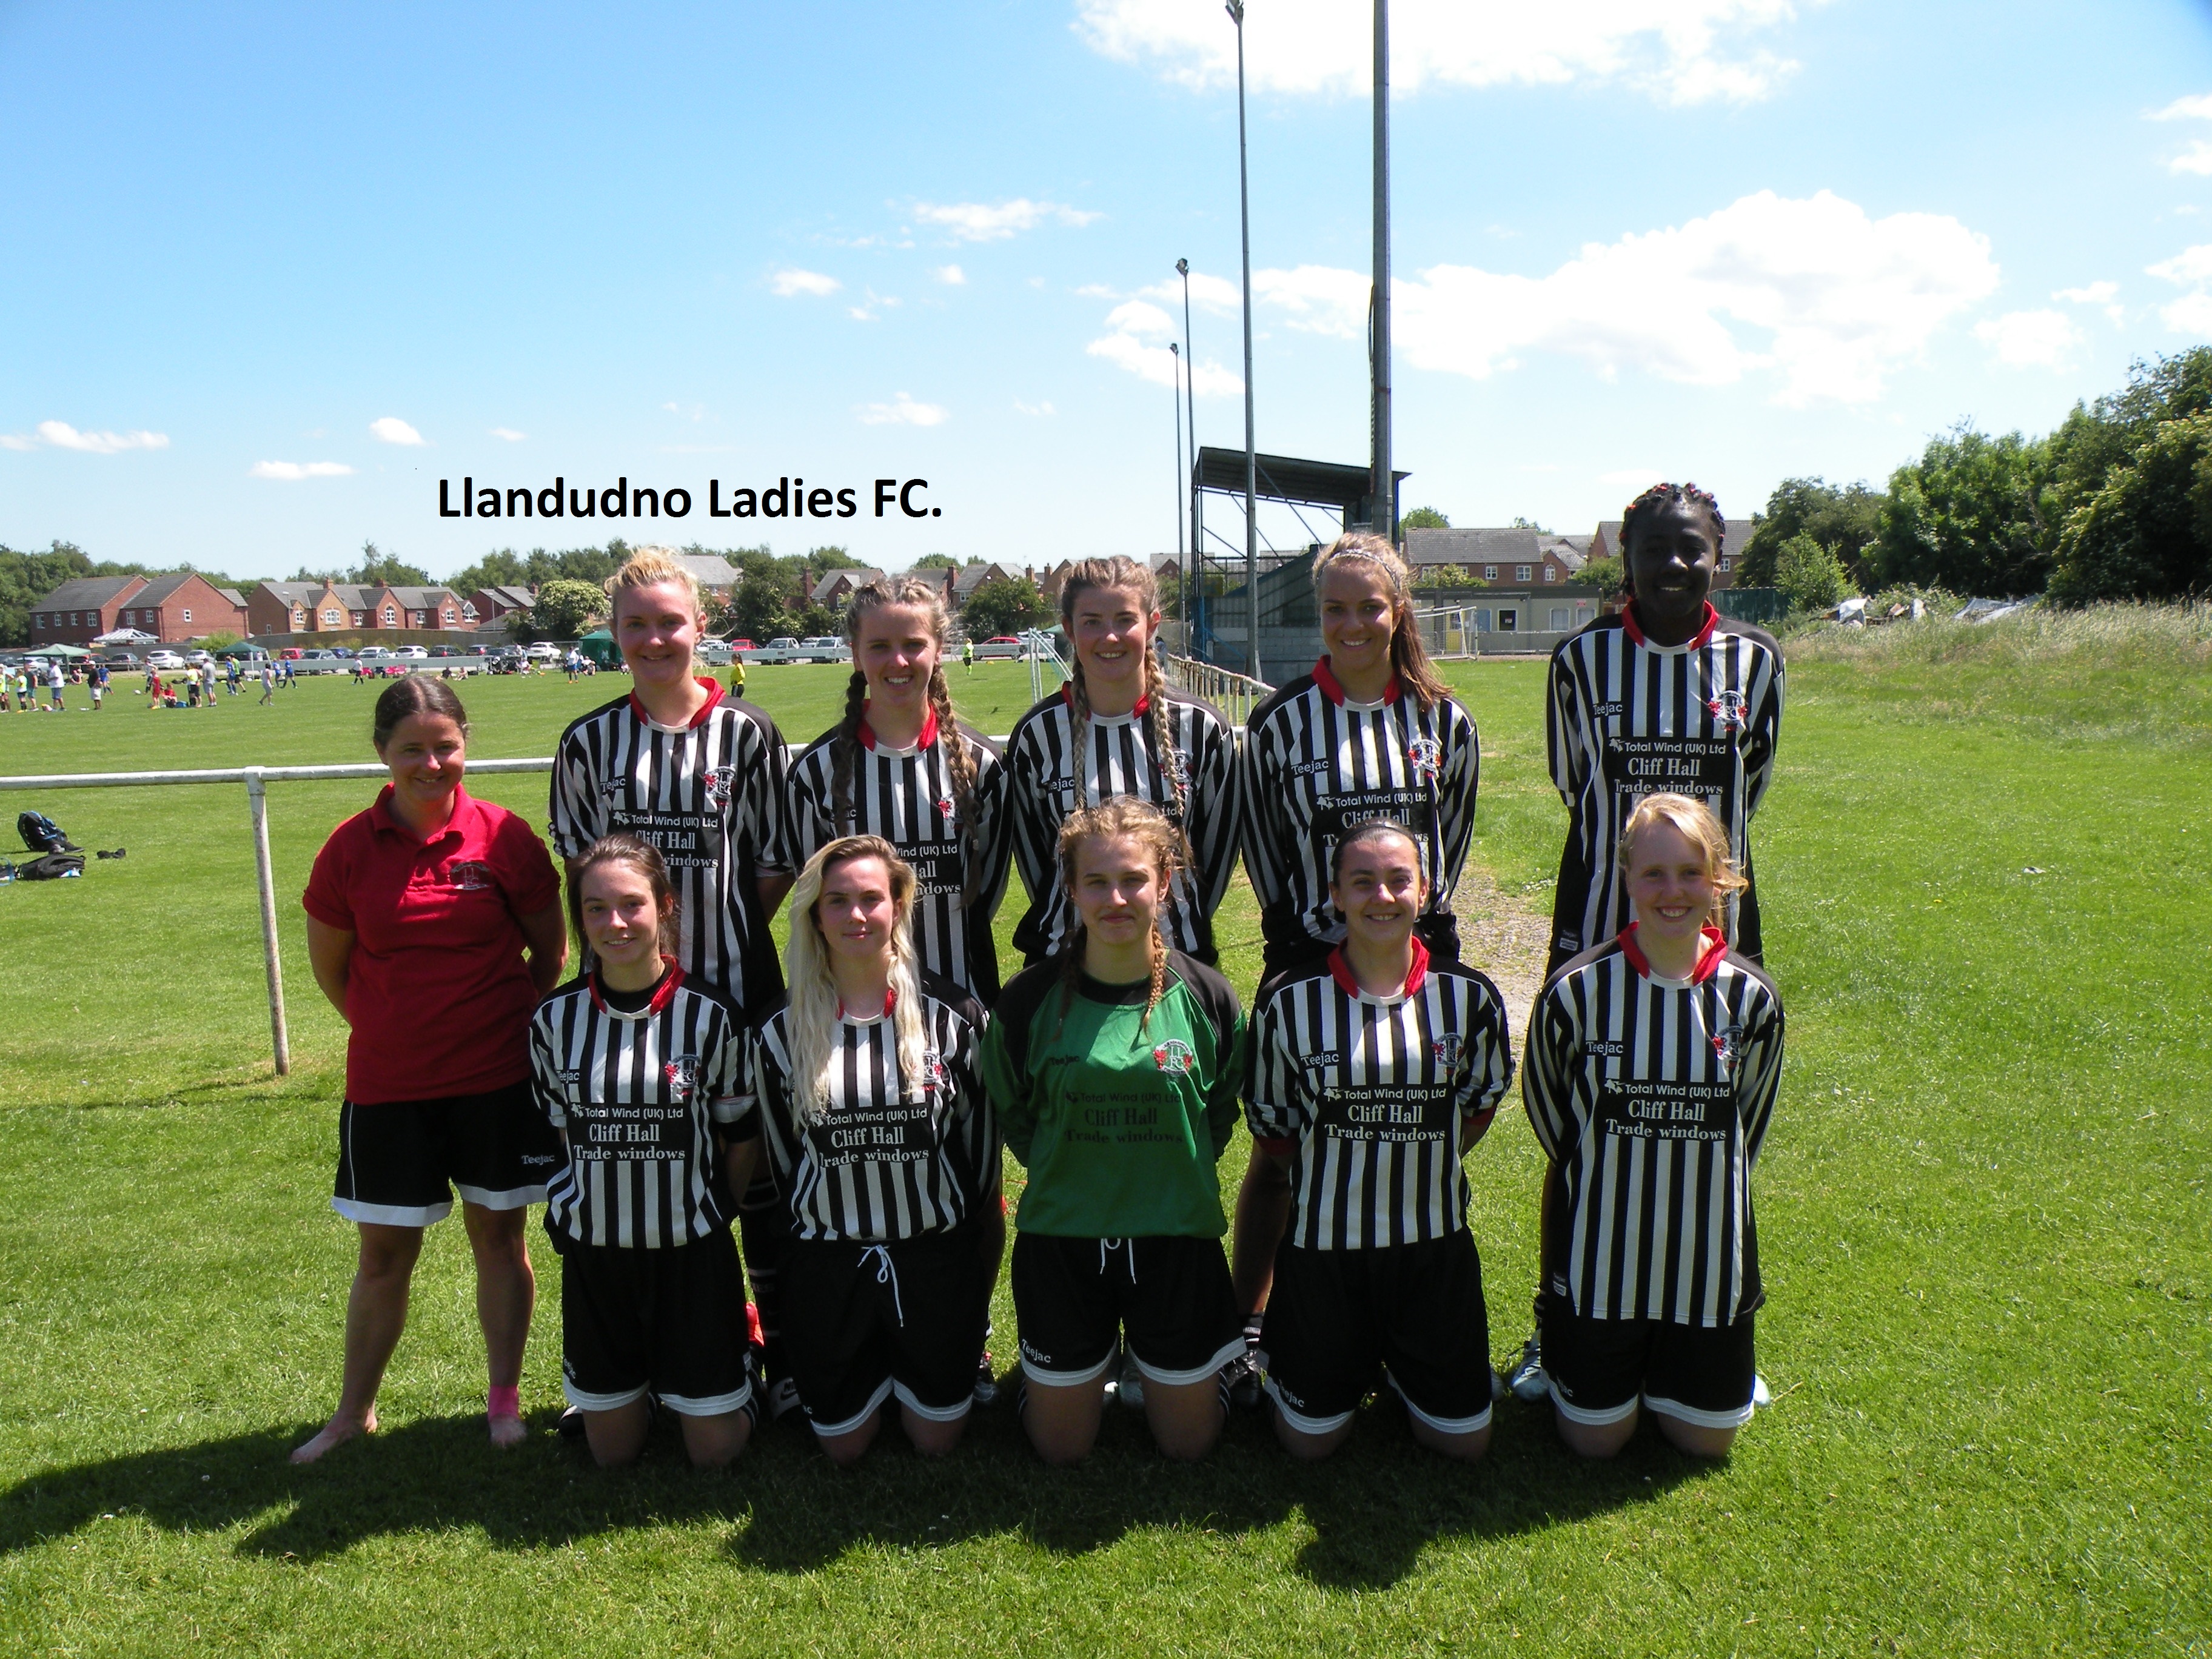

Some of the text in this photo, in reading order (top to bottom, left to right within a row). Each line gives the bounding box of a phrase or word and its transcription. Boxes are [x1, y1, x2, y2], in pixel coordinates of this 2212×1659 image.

[1593, 703, 1623, 716] Teejac
[1625, 742, 1726, 755] Total Wind (UK) Ltd
[1292, 760, 1329, 776] Teejac
[1628, 758, 1700, 777] Cliff Hall
[1614, 779, 1723, 794] Trade windows
[1336, 793, 1427, 808] Total Wind (UK) Ltd
[632, 815, 719, 828] Total Wind (UK) Ltd
[668, 832, 696, 850] Hall
[919, 846, 939, 857] (UK)
[942, 844, 958, 854] Ltd
[1586, 1041, 1623, 1056] Teejac
[1301, 1053, 1339, 1067] Teejac
[1081, 1093, 1106, 1103] Total
[1110, 1093, 1138, 1103] Wind
[1141, 1093, 1161, 1104] (UK)
[1344, 1088, 1446, 1102] Total Wind (UK) Ltd
[1626, 1084, 1730, 1099] Total Wind (UK) Ltd
[585, 1108, 683, 1120] Total Wind (UK) Ltd
[825, 1108, 928, 1125] Total Wind (UK) Ltd
[1085, 1108, 1158, 1126] Cliff Hall
[1348, 1105, 1423, 1123] Cliff Hall
[1628, 1099, 1705, 1122] Cliff Hall
[589, 1124, 660, 1142] Cliff Hall
[831, 1126, 905, 1148] Cliff Hall
[1065, 1129, 1182, 1143] Trade windows
[1325, 1124, 1445, 1142] Trade windows
[1606, 1119, 1726, 1141] Trade windows
[522, 1155, 555, 1165] Teejac
[574, 1145, 685, 1160] Trade windows
[865, 1149, 929, 1162] windows
[1021, 1338, 1051, 1363] Teejac
